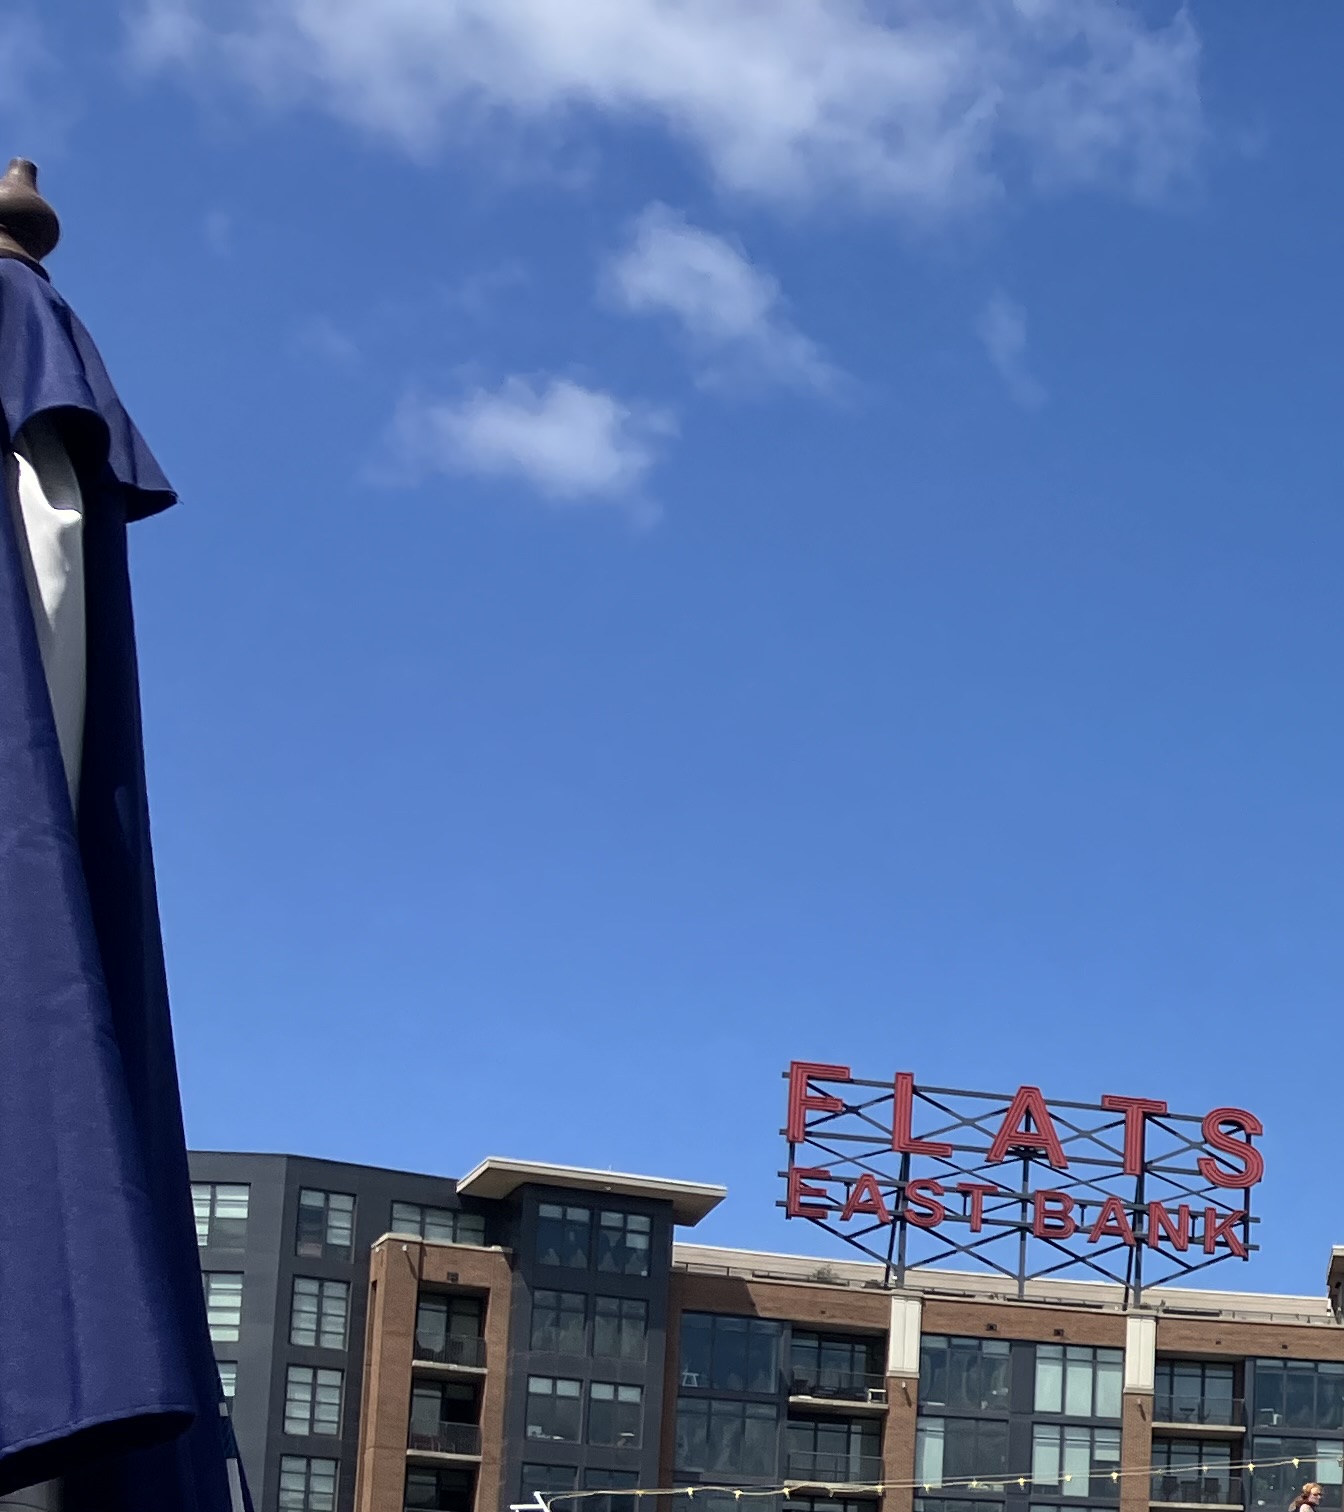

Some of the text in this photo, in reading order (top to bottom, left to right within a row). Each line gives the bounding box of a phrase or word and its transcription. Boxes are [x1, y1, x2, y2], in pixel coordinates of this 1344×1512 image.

[787, 1060, 1264, 1190] FLATS
[787, 1167, 1248, 1258] EAST BANK
